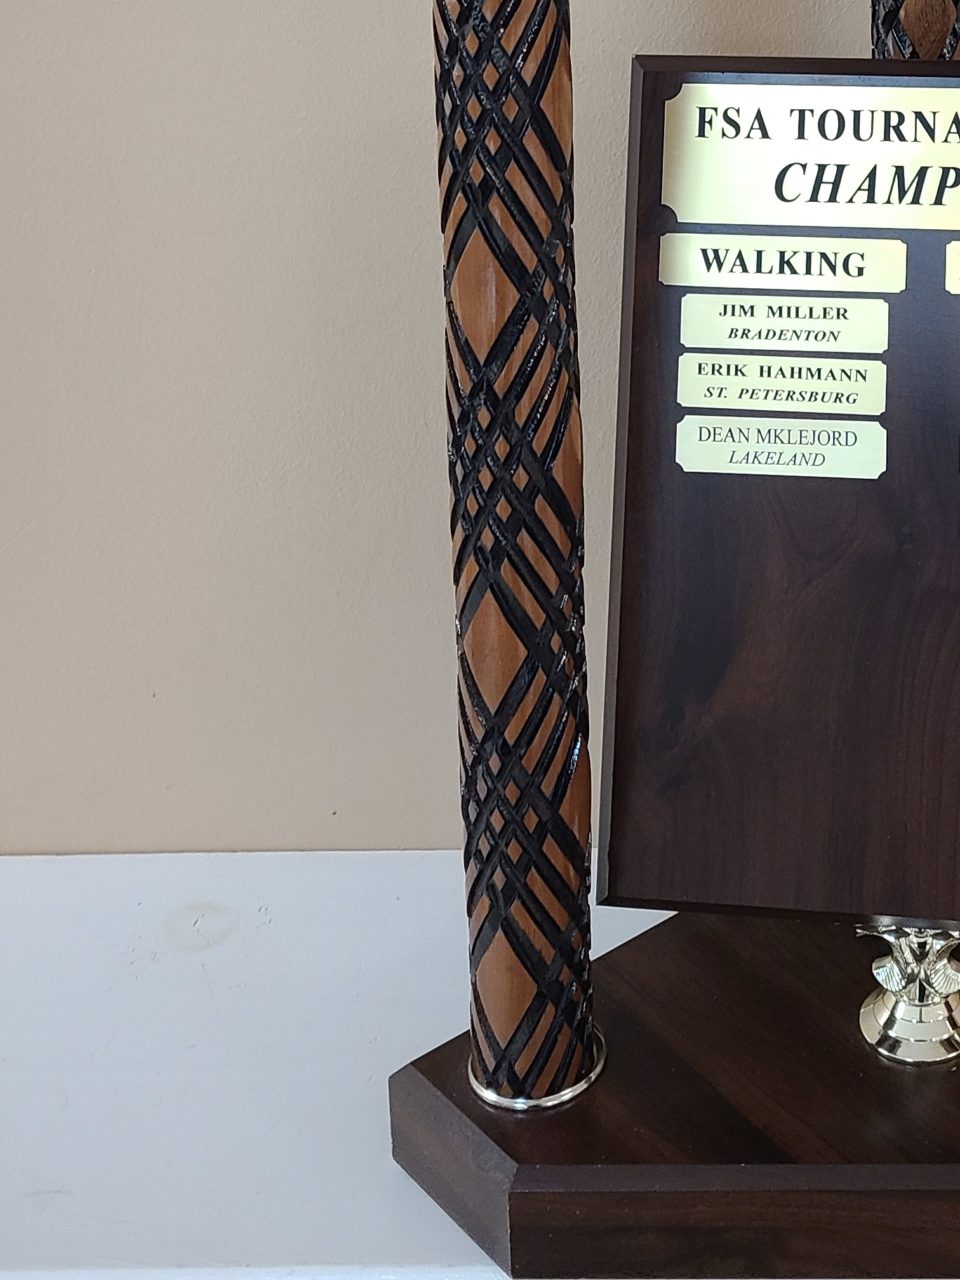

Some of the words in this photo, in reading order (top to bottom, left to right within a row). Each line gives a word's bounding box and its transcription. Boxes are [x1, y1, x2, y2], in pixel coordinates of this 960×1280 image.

[694, 106, 772, 141] FSA
[699, 248, 867, 278] WALKING
[719, 304, 755, 318] JIM
[766, 305, 849, 320] MILLER
[728, 328, 841, 342] BRADENTON
[697, 363, 748, 377] ERIK
[759, 365, 868, 382] HAHMANN
[704, 386, 728, 399] ST.
[738, 388, 859, 404] PETERSBURG
[698, 426, 750, 443] DEAN
[756, 428, 857, 447] MKLEJORD
[728, 451, 826, 467] LAKELAND
